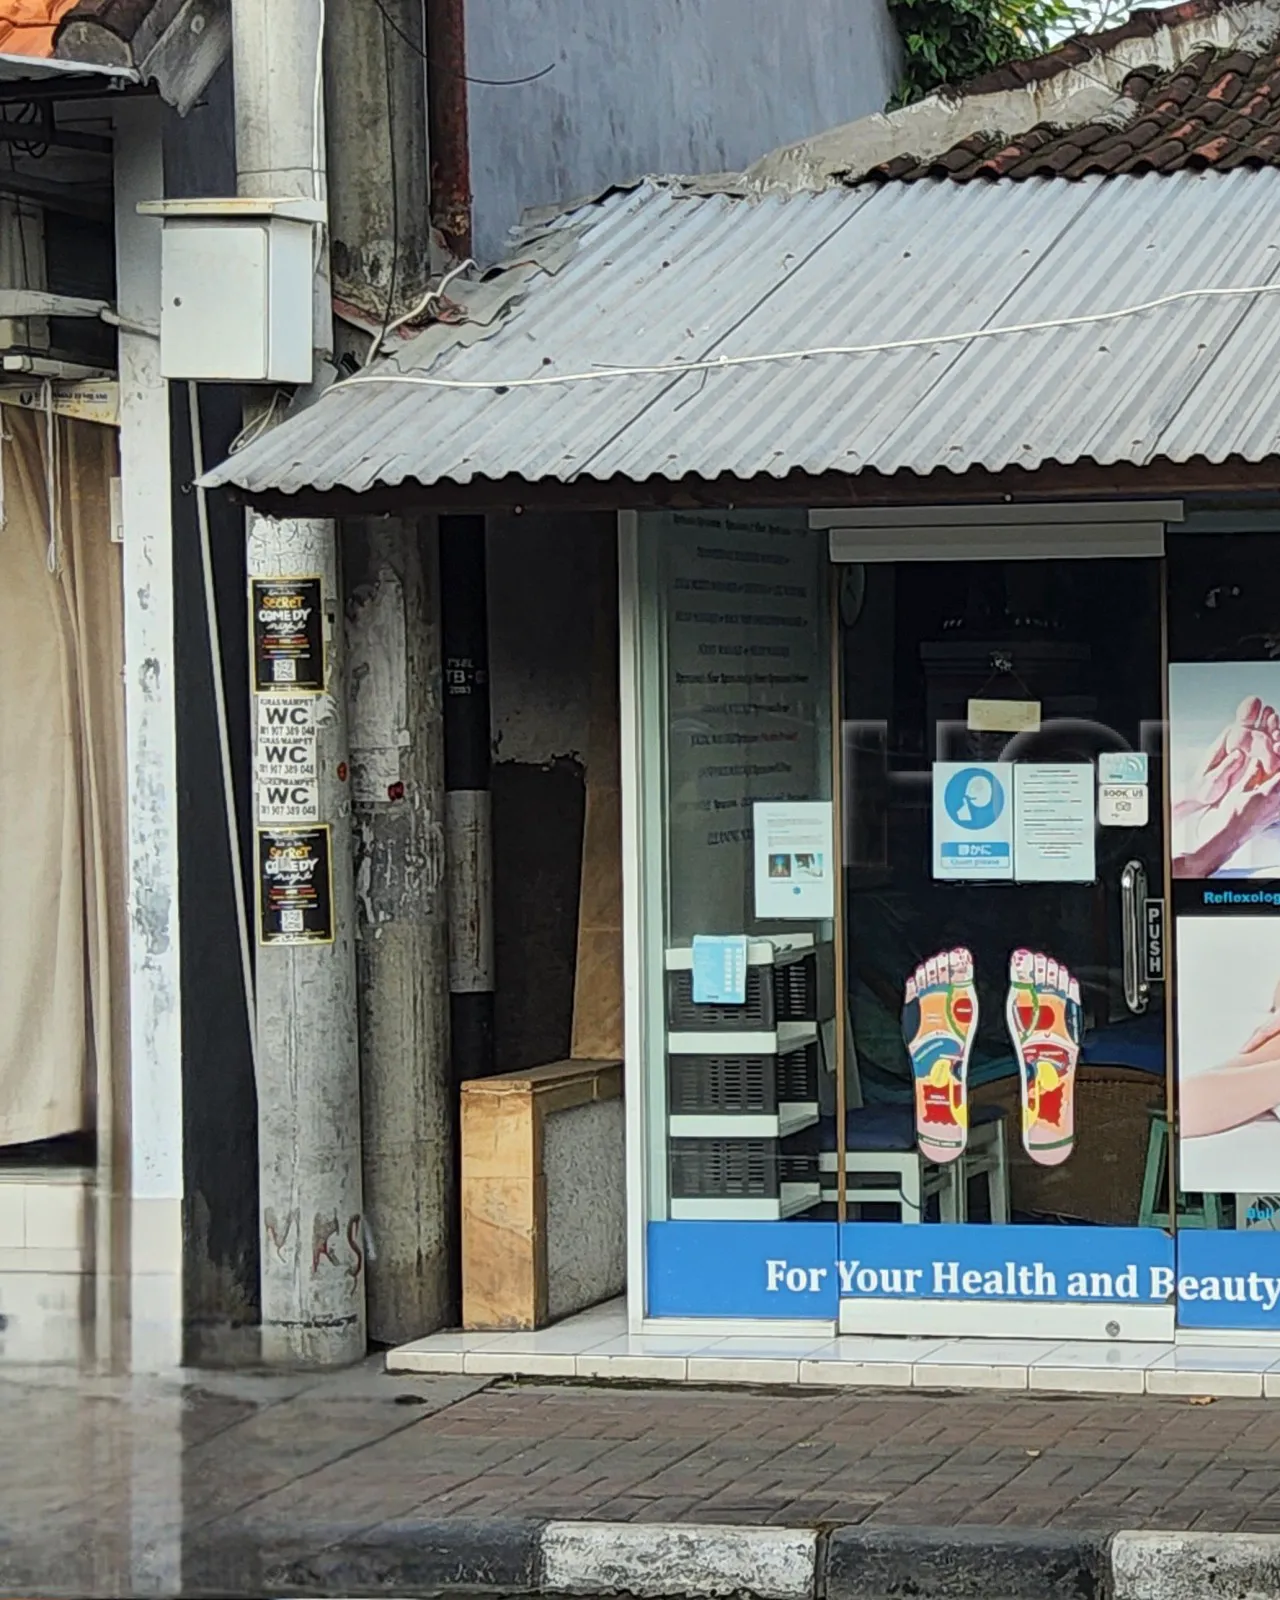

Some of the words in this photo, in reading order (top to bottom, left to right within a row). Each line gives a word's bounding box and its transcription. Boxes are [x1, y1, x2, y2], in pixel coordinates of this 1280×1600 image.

[258, 607, 312, 622] COMEDY
[265, 708, 309, 725] WC
[265, 746, 308, 763] WC
[267, 787, 309, 804] WC
[1104, 789, 1128, 798] BOOK
[1132, 789, 1143, 797] US
[1148, 908, 1161, 973] PUSH
[765, 1260, 827, 1292] For
[835, 1260, 922, 1293] Your
[932, 1261, 1058, 1296] Health
[1067, 1265, 1137, 1298] and
